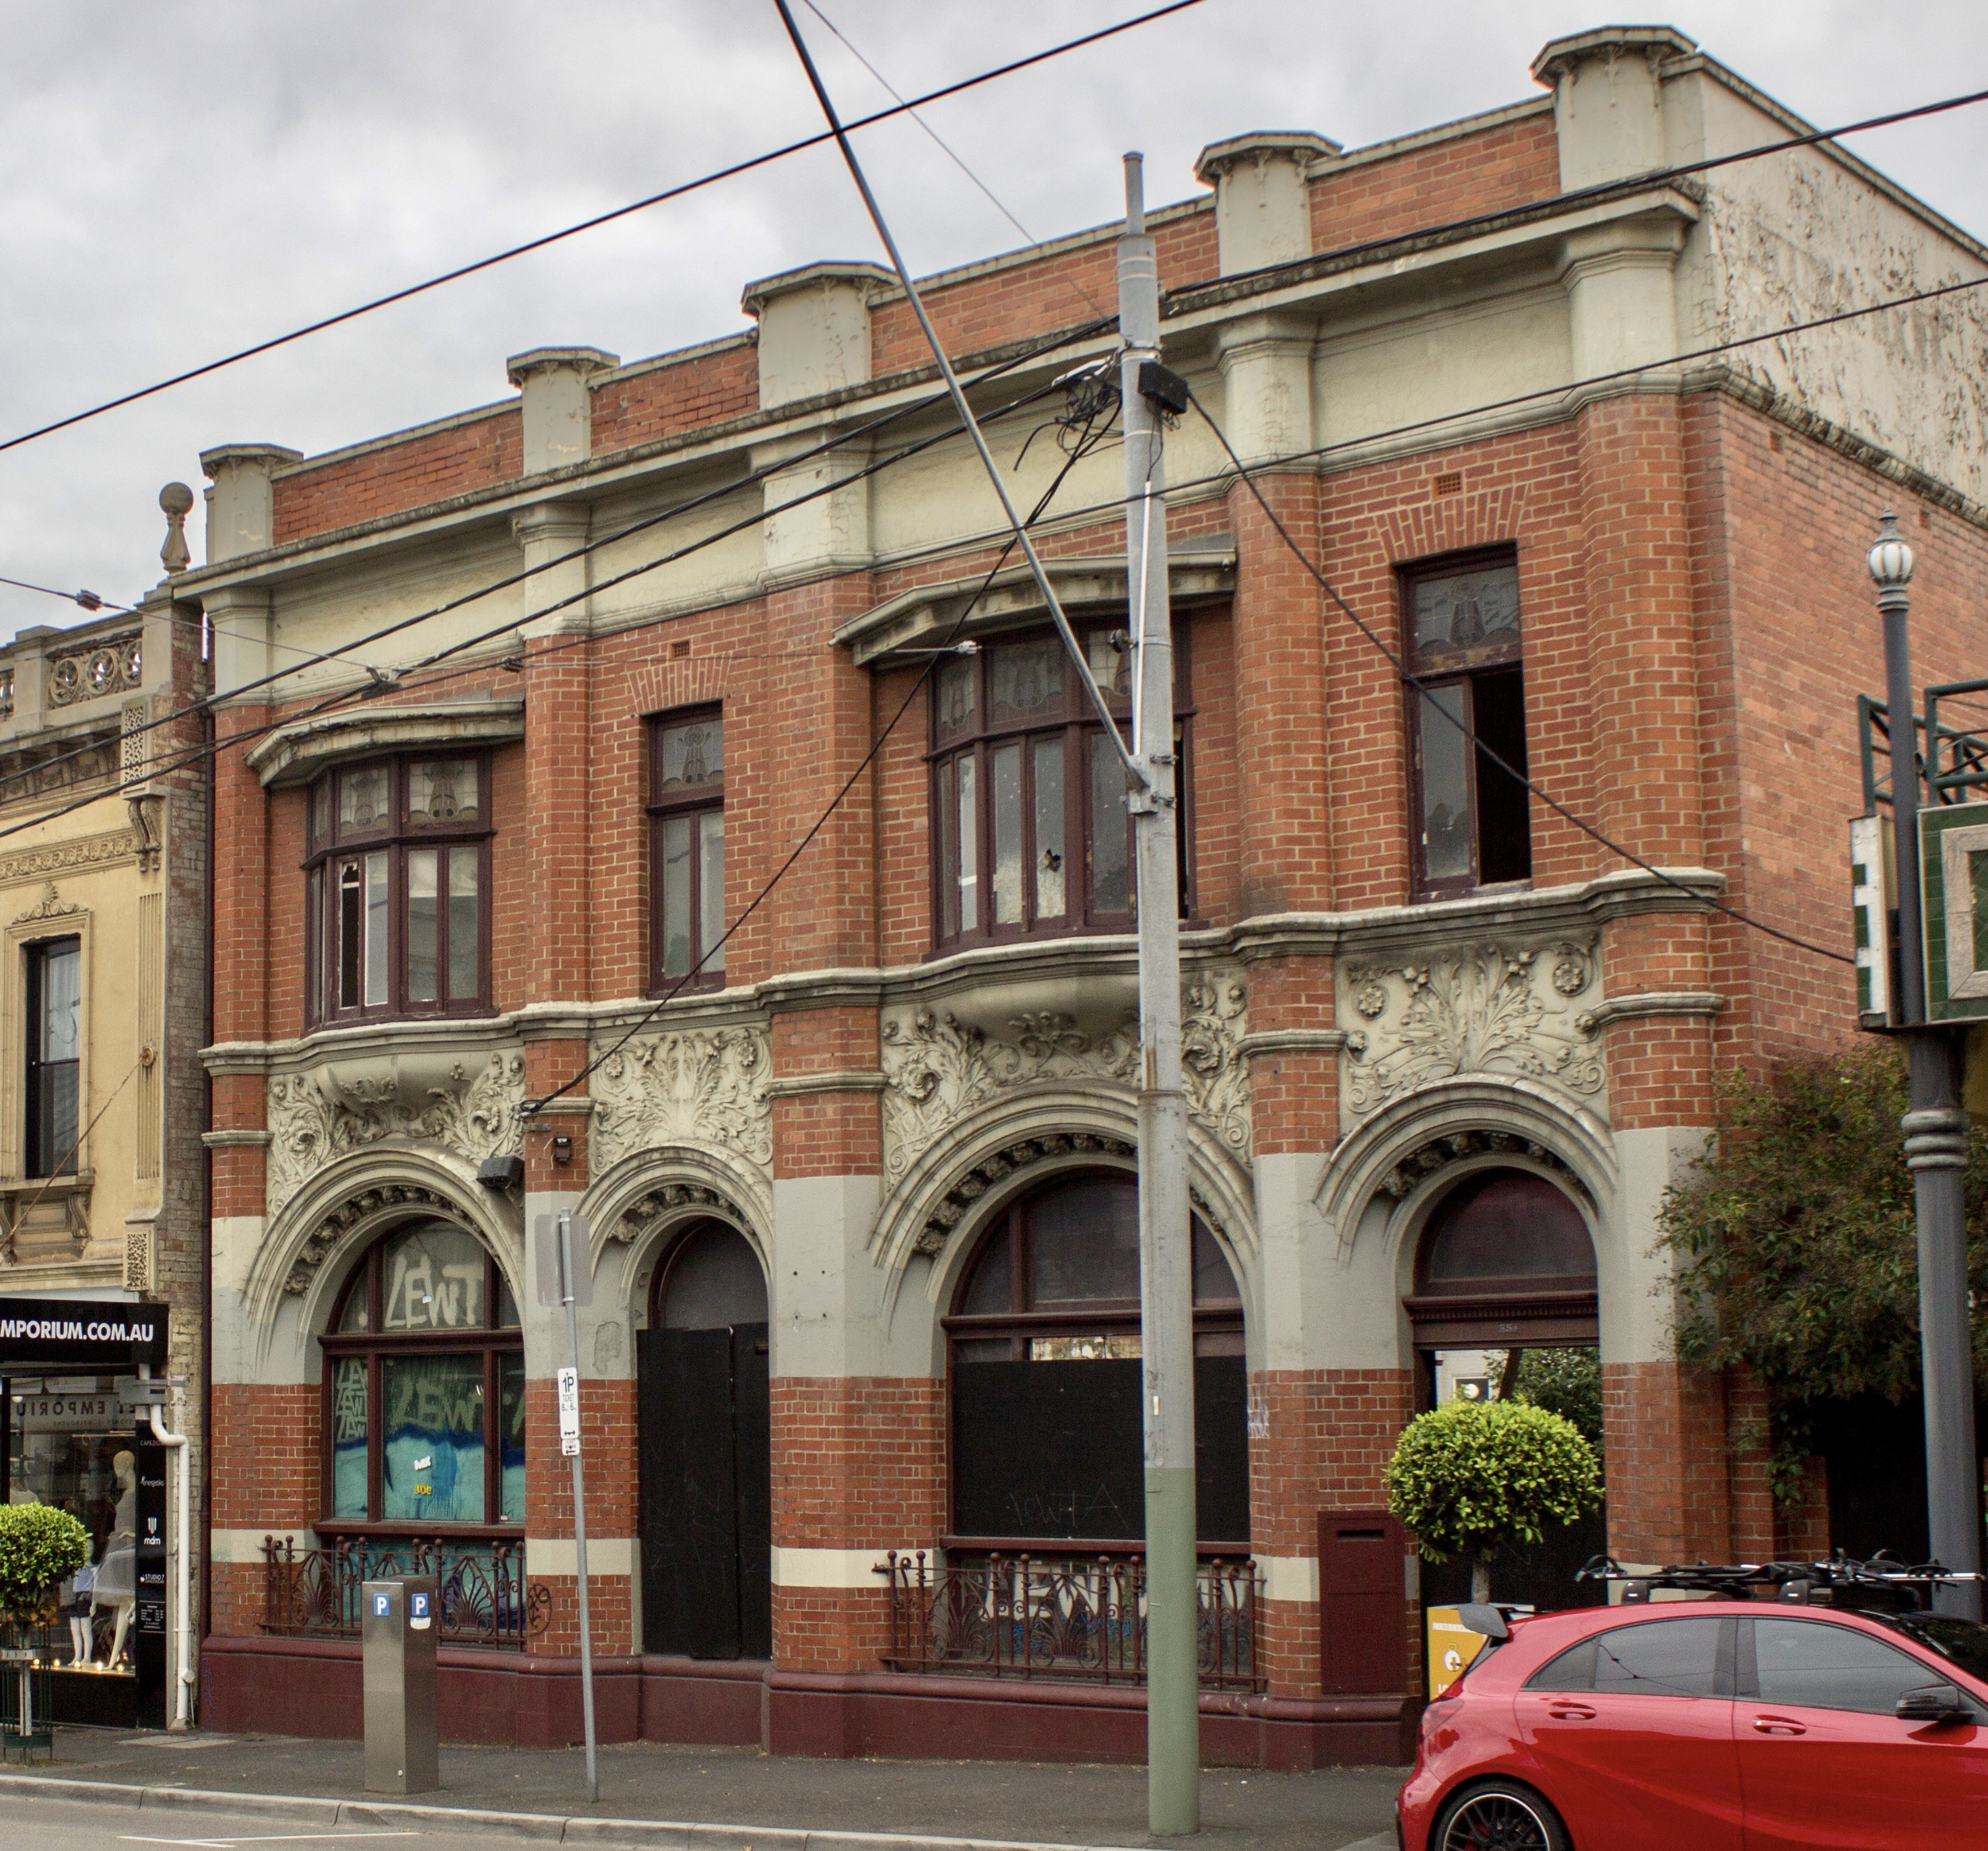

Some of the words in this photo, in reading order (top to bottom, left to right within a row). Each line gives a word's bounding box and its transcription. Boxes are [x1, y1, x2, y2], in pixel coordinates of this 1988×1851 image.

[0, 1320, 154, 1342] MPORIUM.COM.AU
[562, 1376, 574, 1392] 1P
[143, 1536, 161, 1545] mdm
[377, 1596, 387, 1615] P
[416, 1596, 426, 1615] P
